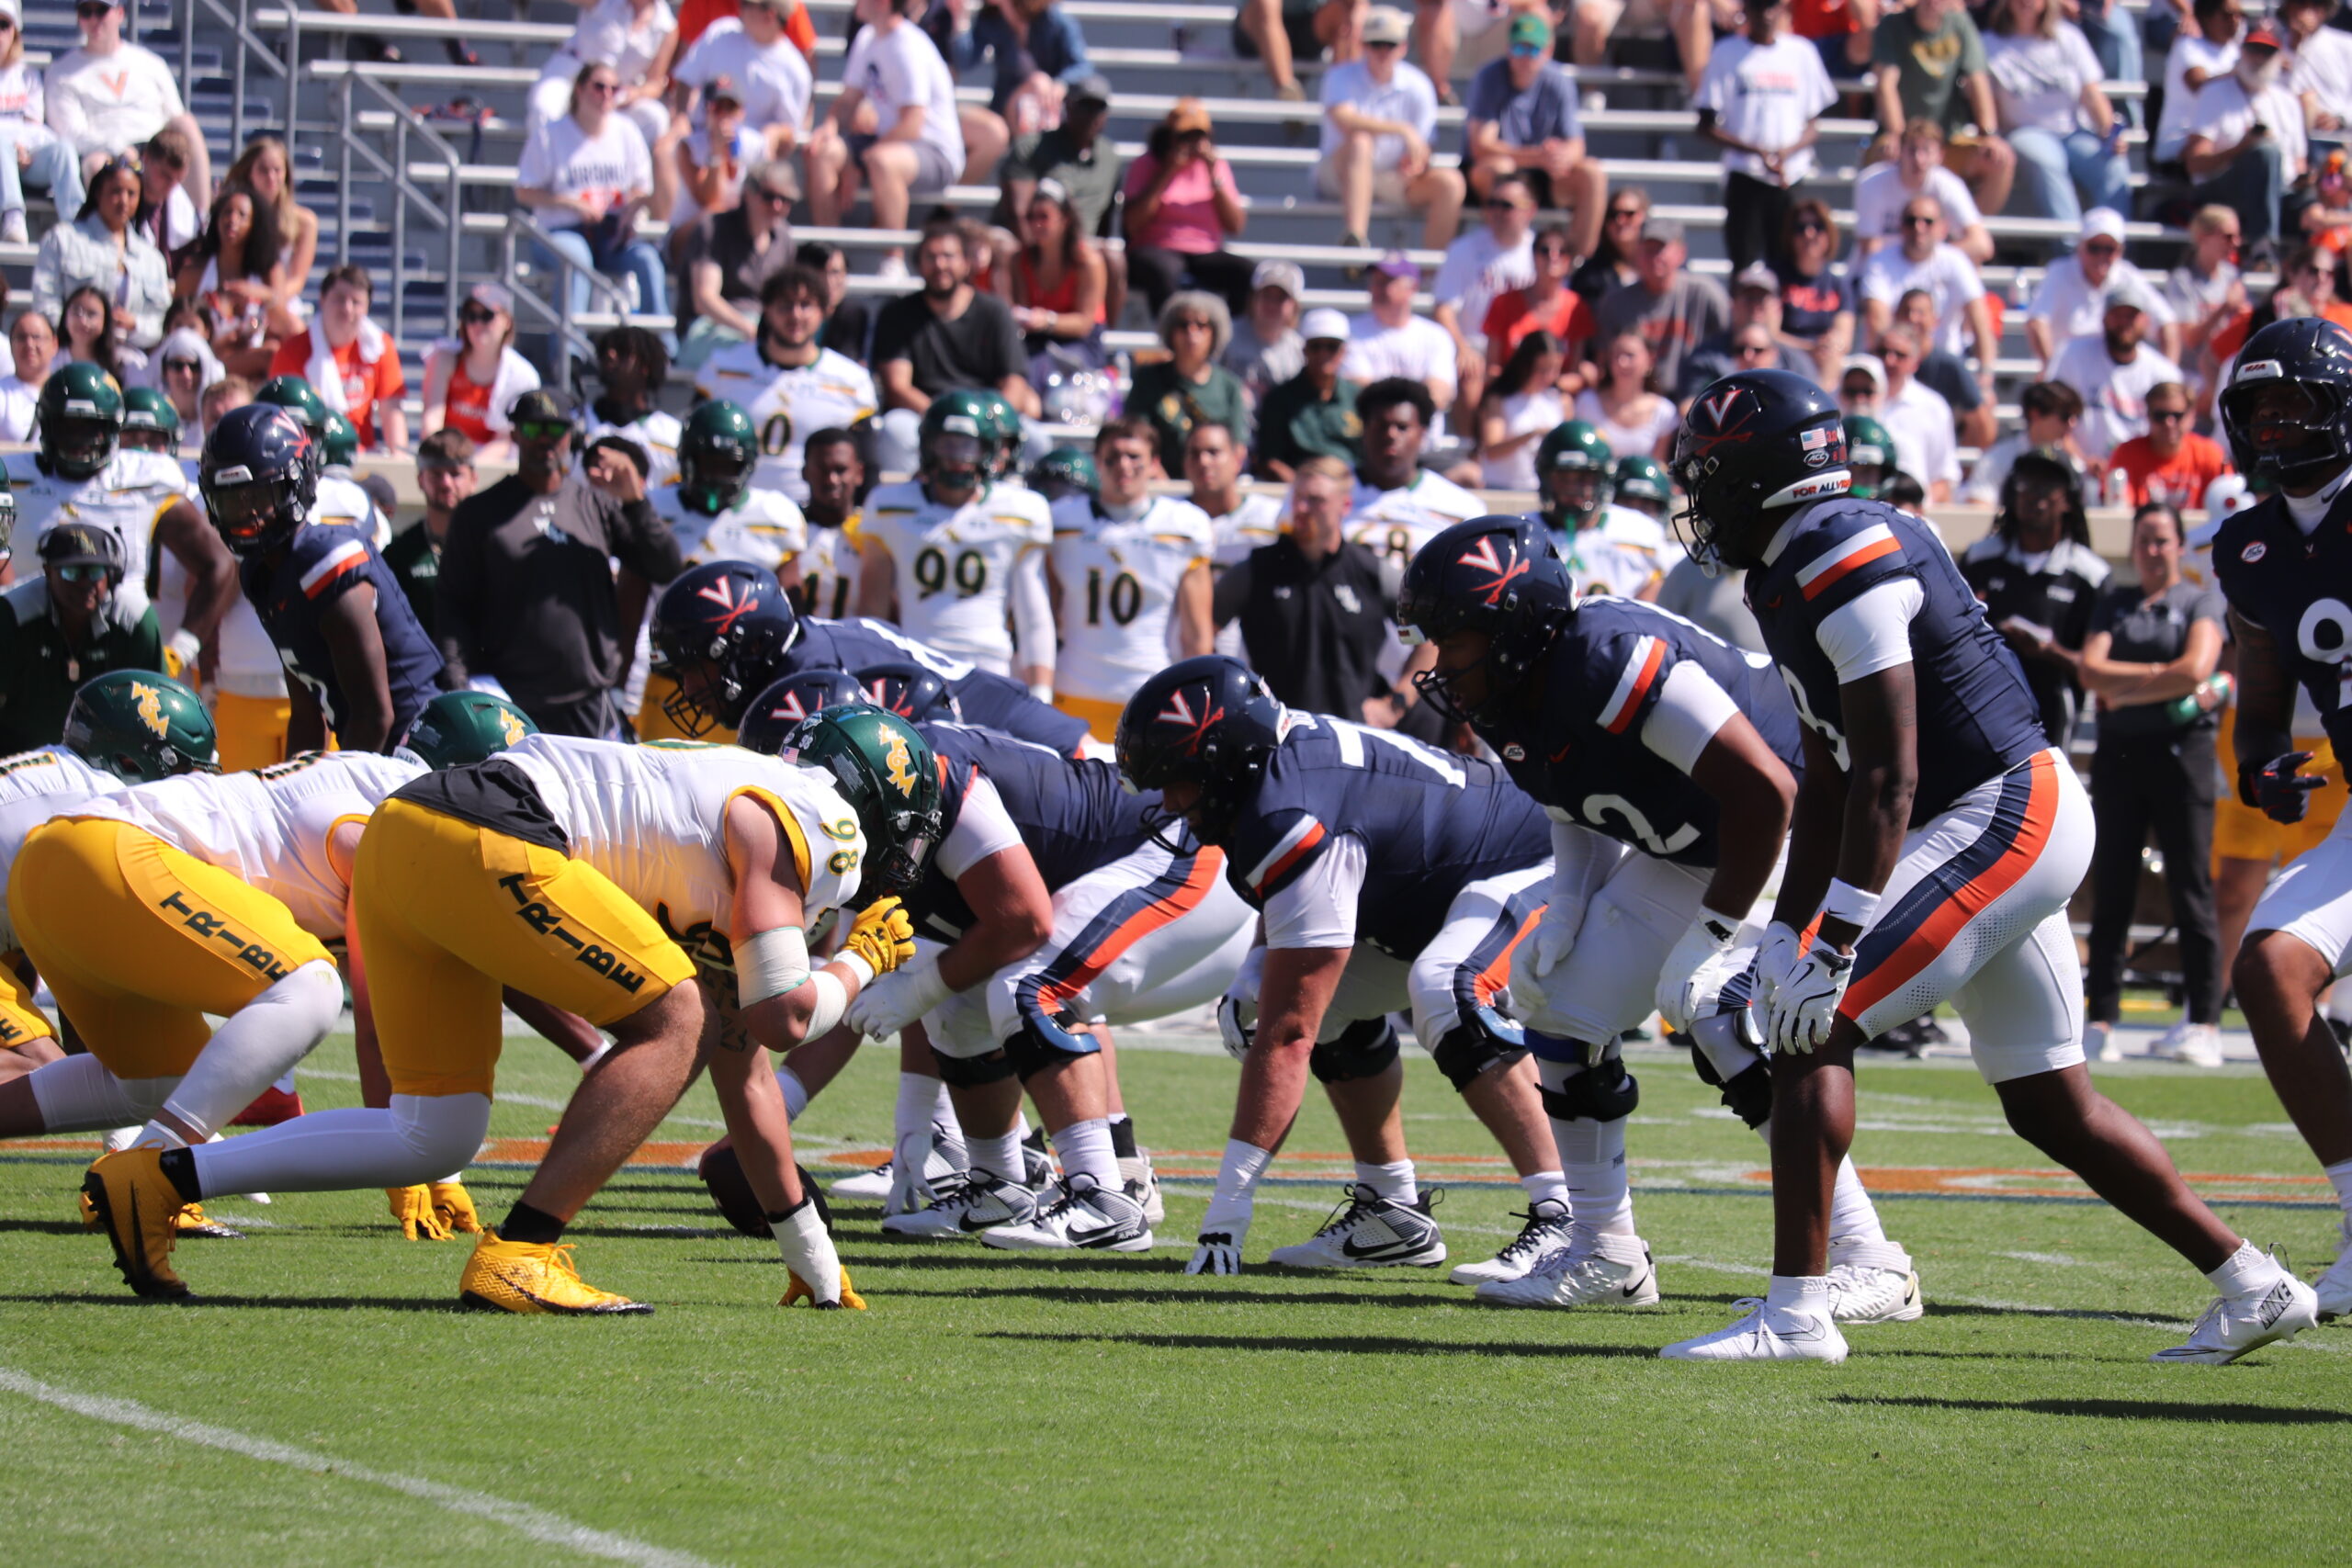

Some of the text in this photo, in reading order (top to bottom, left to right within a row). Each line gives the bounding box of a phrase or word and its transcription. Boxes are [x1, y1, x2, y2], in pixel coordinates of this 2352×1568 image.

[1792, 485, 1817, 499] FOR
[1819, 481, 1835, 493] ALL
[913, 544, 988, 601] 99
[1086, 567, 1143, 627] 10
[820, 817, 860, 876] 98
[159, 890, 290, 983] TRIBE
[498, 873, 647, 995] TRIBE
[2258, 1279, 2295, 1331] NIKE
